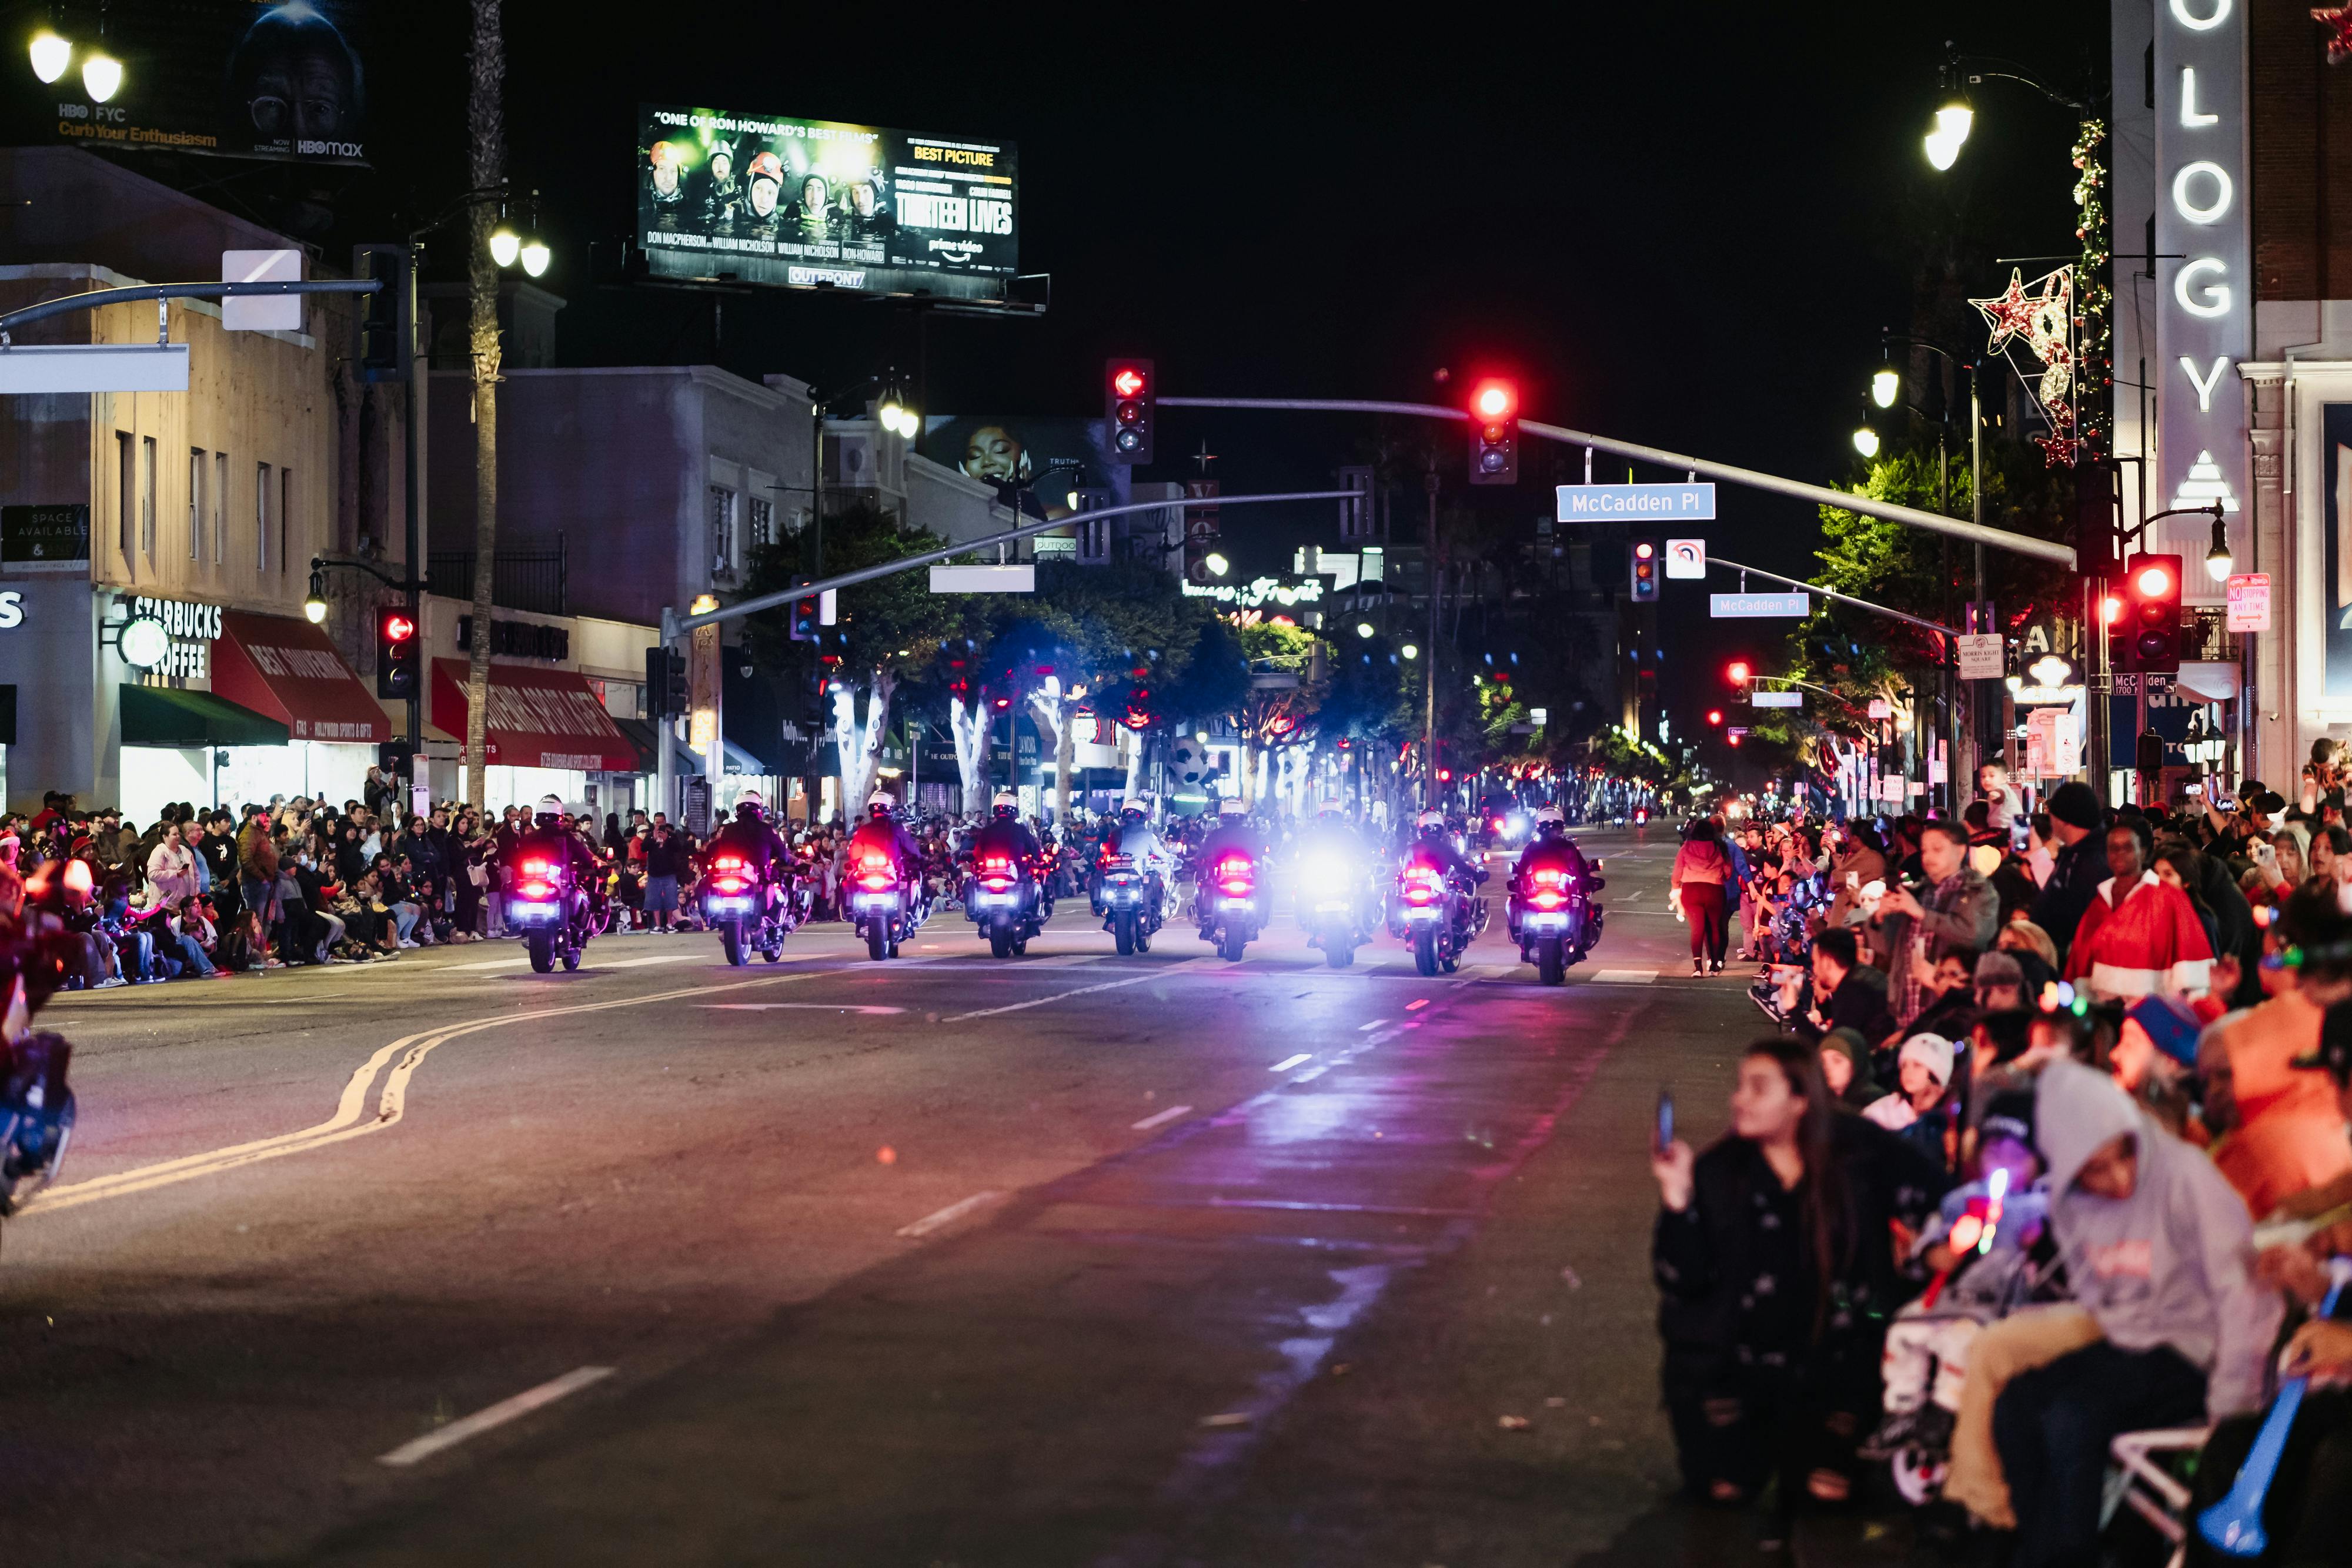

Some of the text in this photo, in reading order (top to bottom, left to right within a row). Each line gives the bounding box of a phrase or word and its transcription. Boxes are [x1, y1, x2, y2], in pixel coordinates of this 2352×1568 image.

[59, 103, 126, 122] HBO FYC
[59, 121, 216, 147] Curb Your Enthusiasm
[690, 115, 706, 128] OF
[709, 117, 736, 132] RON
[808, 127, 837, 142] BEST
[914, 146, 993, 166] BEST PICTURE
[970, 199, 1013, 235] LIVES
[647, 231, 662, 243] DON
[663, 232, 706, 248] MACPHERSON
[713, 236, 738, 250] WILLIAM
[739, 239, 775, 253] NICHOLSON
[778, 242, 803, 255] WILLIAM
[804, 244, 839, 259] NICHOLSON
[929, 238, 983, 253] prime video
[791, 269, 861, 286] OUTFRONT
[1572, 493, 1699, 513] McCadden Pl
[32, 513, 72, 523] SPACE
[19, 526, 88, 536] AVAILABLE
[1037, 541, 1075, 550] OUTDOO
[2230, 587, 2268, 600] NO STOPPING
[1720, 599, 1799, 611] McCadden Pl
[2234, 602, 2264, 611] ANY TIME
[135, 596, 222, 640] STARBUCKS
[152, 643, 205, 678] OFFEE
[248, 644, 290, 676] BEST
[2115, 676, 2166, 687] McCden
[2116, 686, 2132, 694] 1700
[296, 719, 372, 738] 6743 HOLLYWOOD SPORTS & GIFTS
[541, 752, 550, 767] 6735
[551, 753, 567, 768] SOUVENIRS
